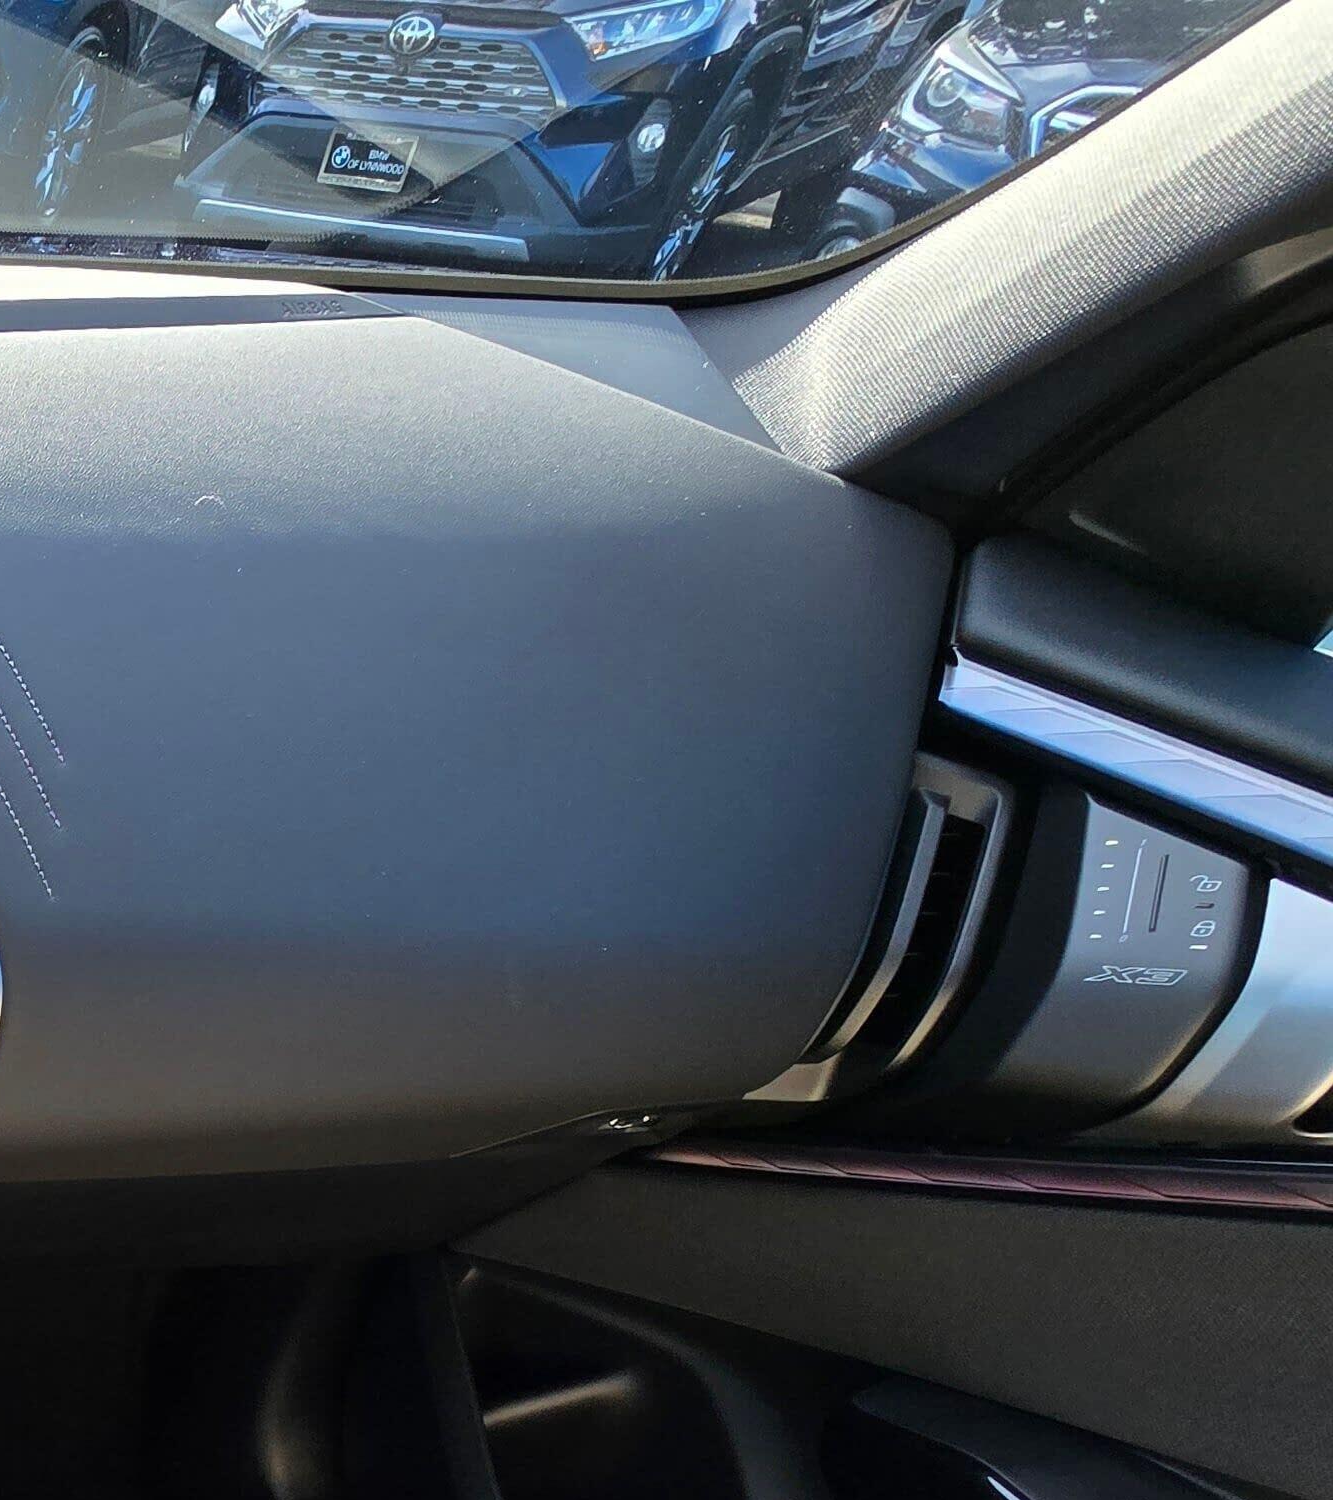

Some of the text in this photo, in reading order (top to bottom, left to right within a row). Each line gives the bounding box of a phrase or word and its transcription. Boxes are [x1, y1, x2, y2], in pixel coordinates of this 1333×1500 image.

[368, 150, 390, 160] BMW
[347, 160, 404, 175] OF LYNNWOOD
[1083, 965, 1188, 985] X3
